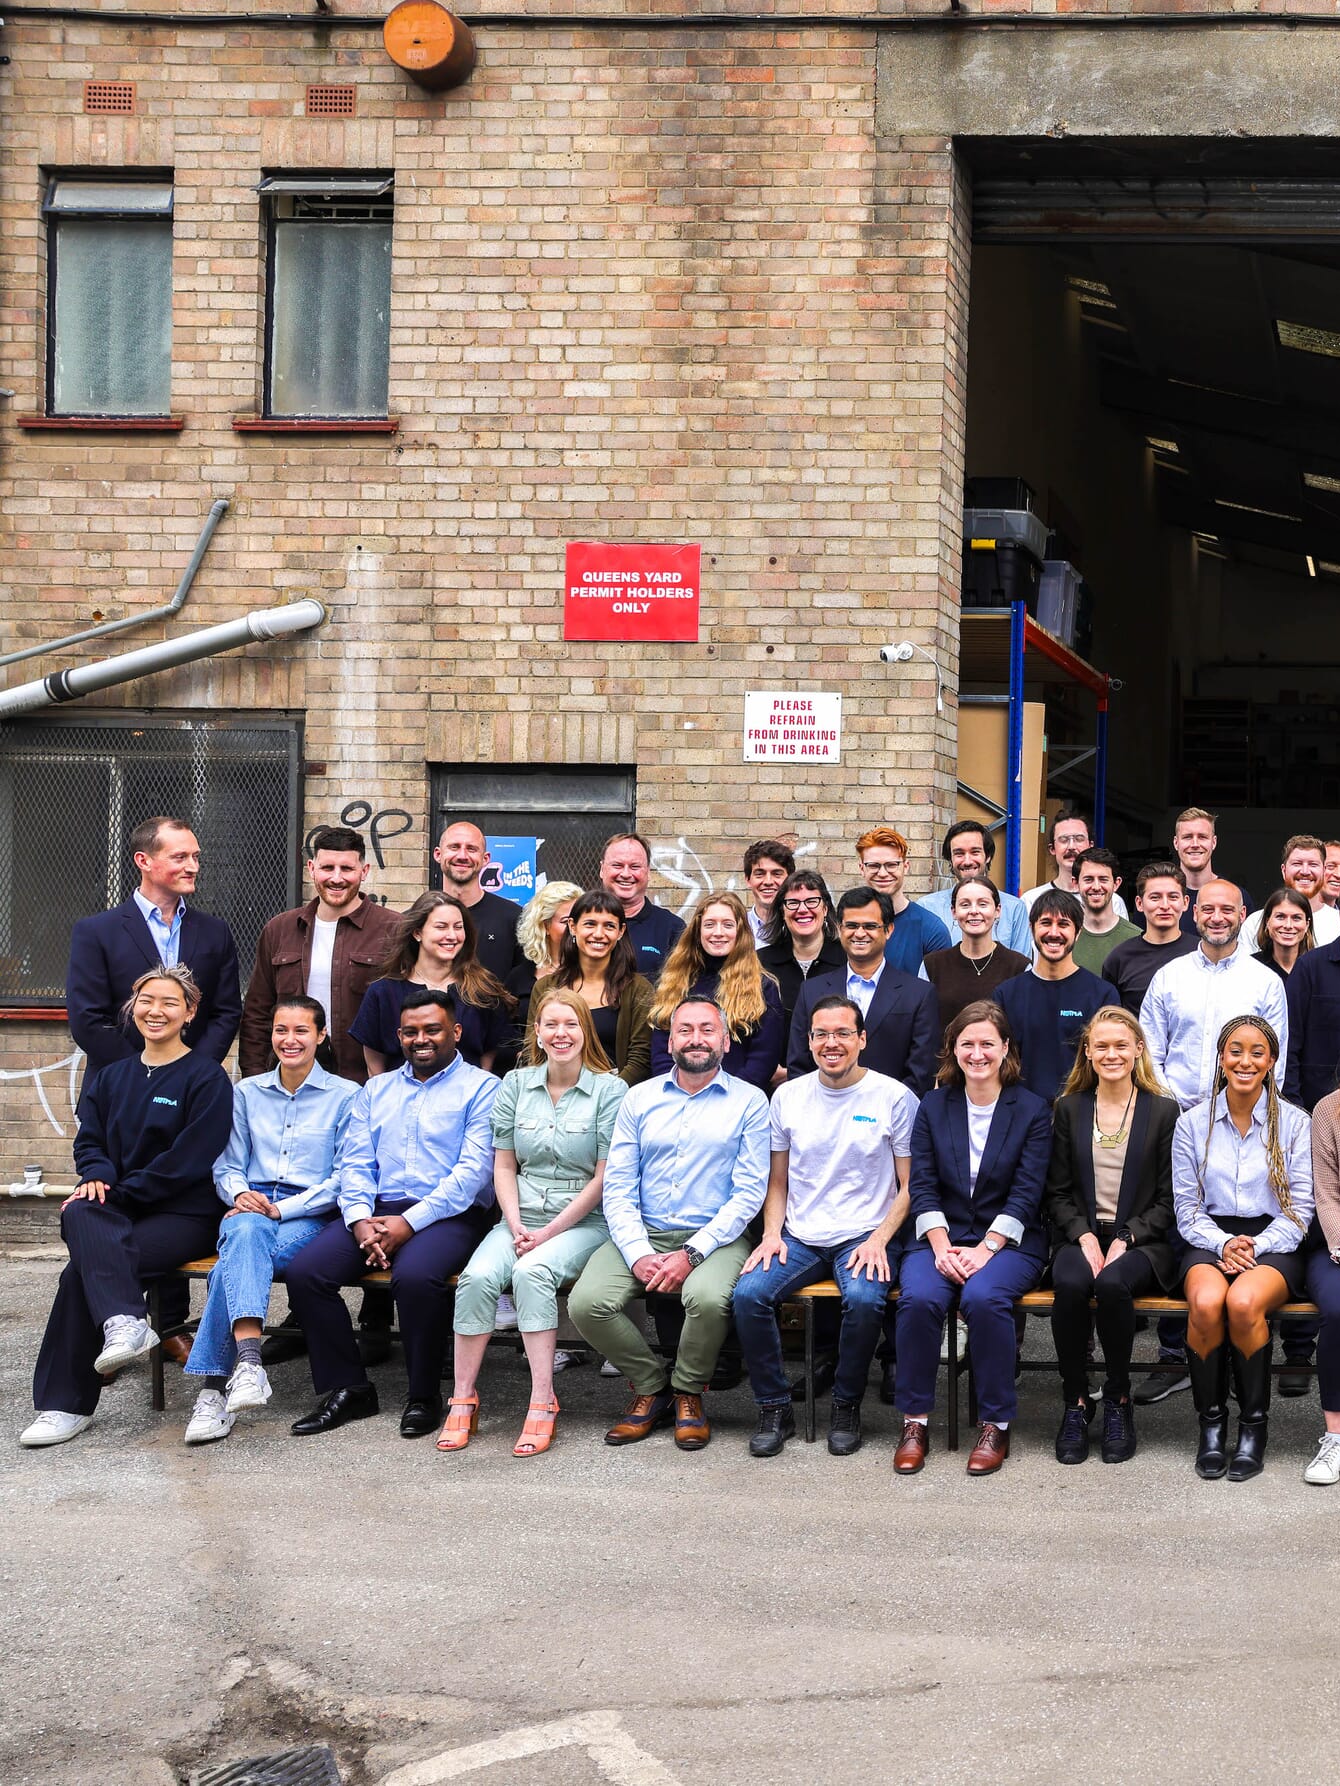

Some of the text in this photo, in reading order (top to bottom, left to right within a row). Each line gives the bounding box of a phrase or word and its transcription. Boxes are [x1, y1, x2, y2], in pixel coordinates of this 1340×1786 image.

[582, 571, 682, 583] QUEENS YARD
[570, 587, 694, 598] PERMIT HOLDERS
[612, 602, 651, 613] ONLY
[773, 700, 813, 711] PLEASE
[769, 715, 816, 726] REFRAIN
[748, 729, 836, 741] FROM DRINKING
[754, 744, 829, 755] IN THIS AREA
[503, 860, 530, 880] IN THE
[503, 874, 534, 889] WEEDS
